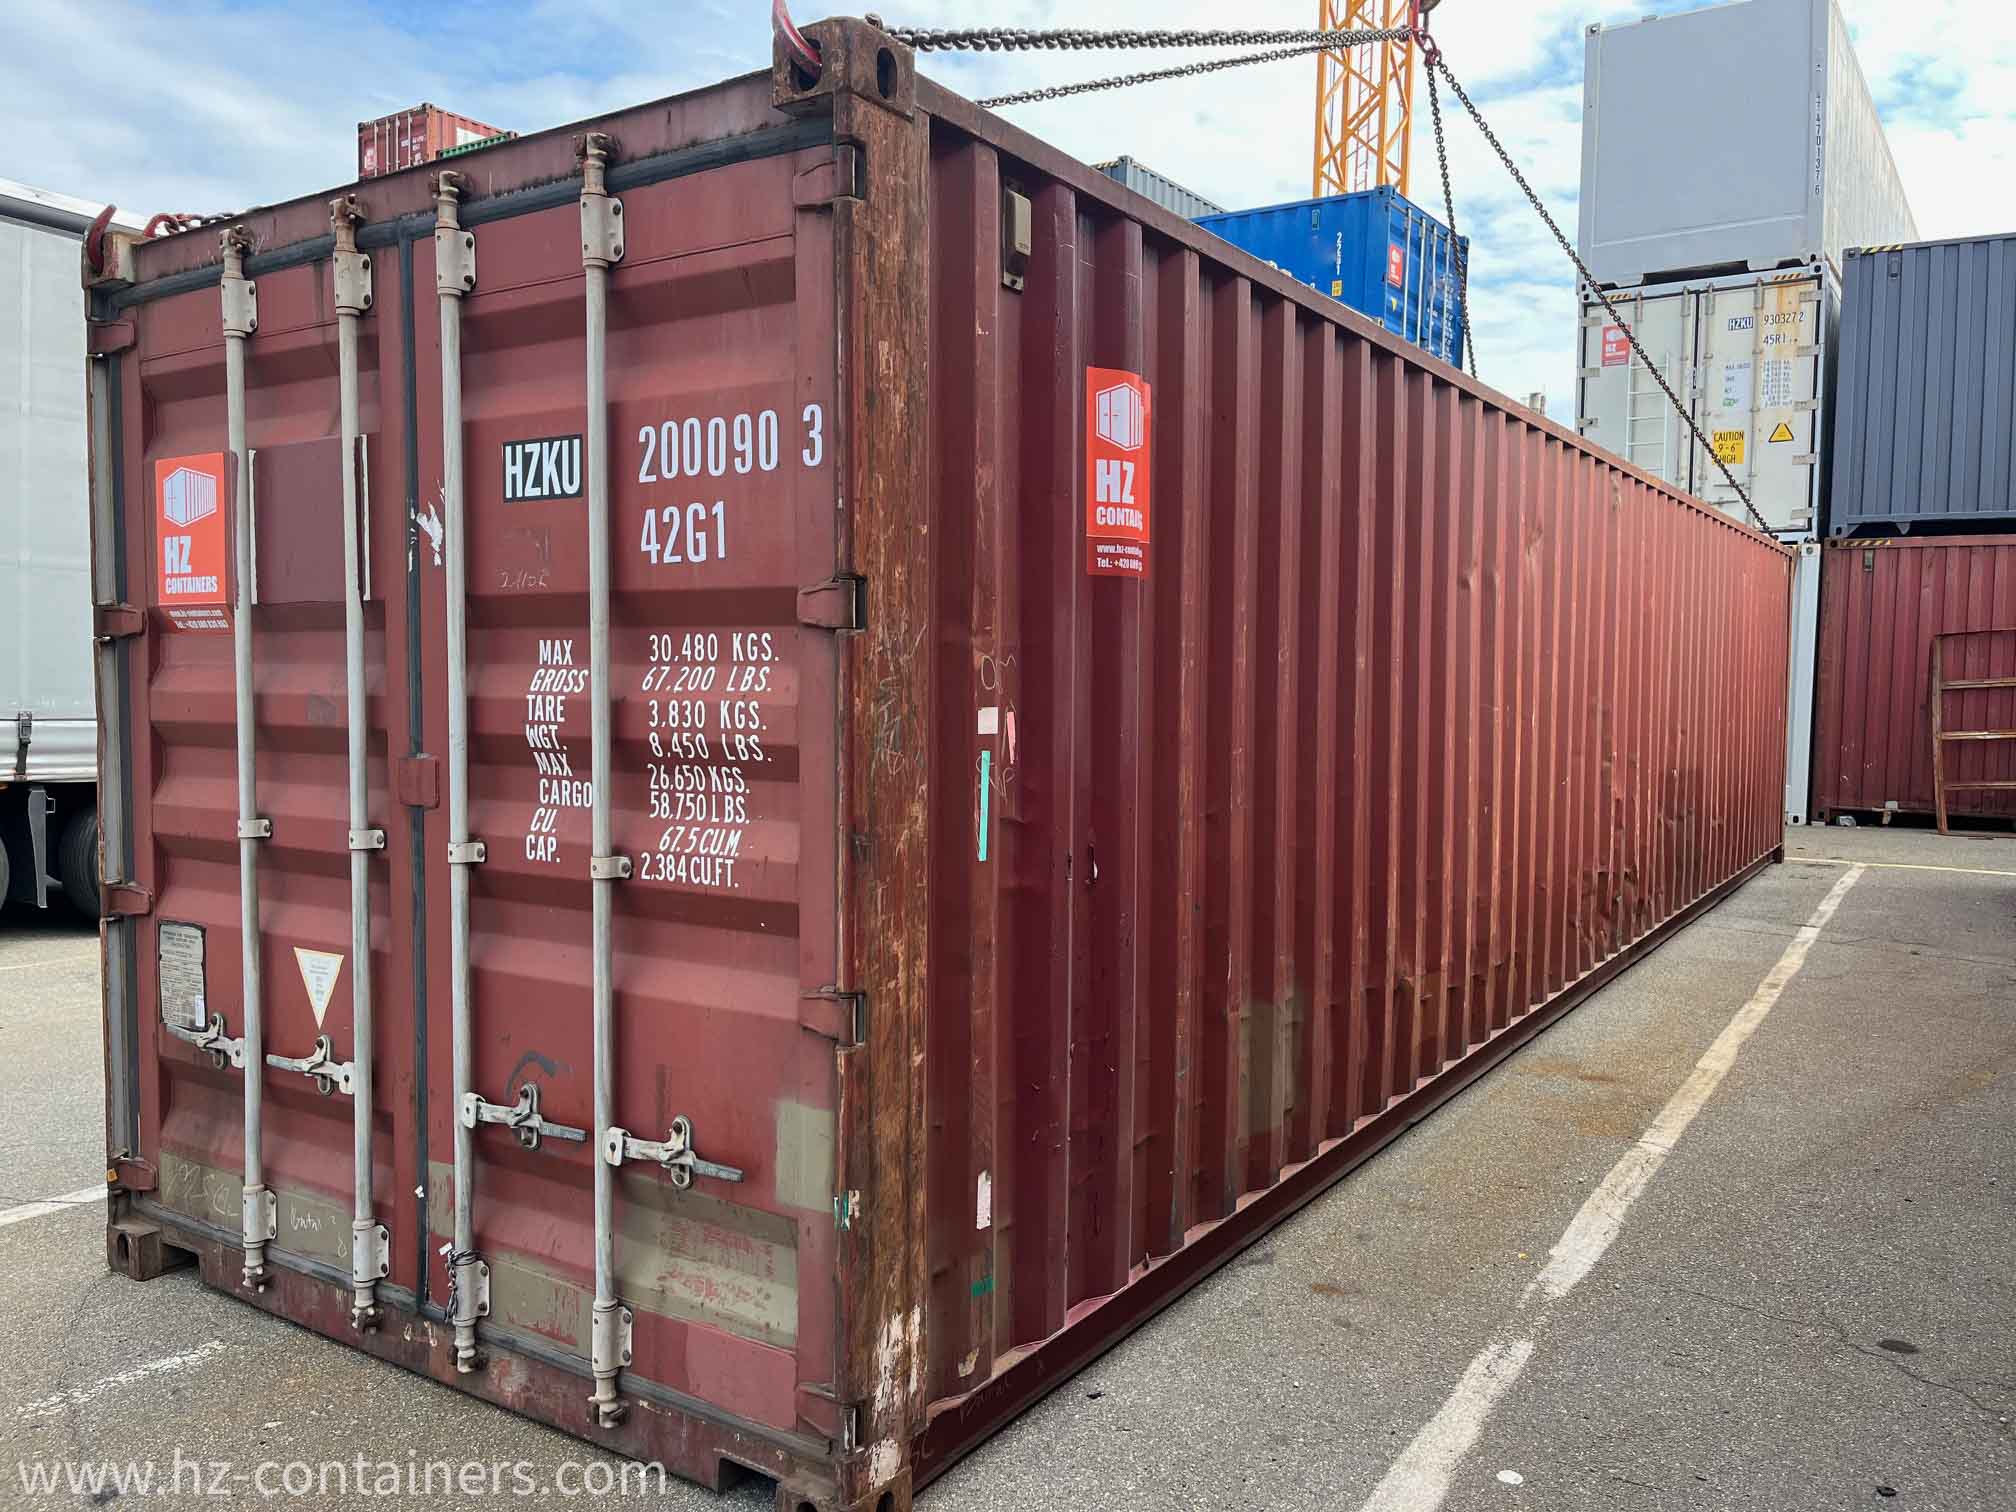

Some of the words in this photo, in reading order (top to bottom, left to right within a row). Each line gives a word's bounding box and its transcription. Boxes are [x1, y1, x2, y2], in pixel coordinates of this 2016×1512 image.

[1728, 317, 1753, 331] HZKU
[1763, 311, 1797, 326] 930327
[1713, 431, 1744, 442] CAUTION
[505, 438, 581, 498] HZKU
[638, 409, 779, 483] 200090
[802, 404, 823, 467] 3
[1096, 459, 1135, 504] HZ
[640, 501, 727, 564] 42G1
[164, 535, 192, 575] HZ
[165, 576, 218, 594] CONTAINERS
[539, 639, 573, 665] MAX
[733, 632, 779, 662] KGS.
[530, 668, 589, 693] GROSS
[726, 666, 772, 692] LBS.
[526, 694, 566, 722] TARE
[720, 700, 767, 730] KGS.
[525, 724, 567, 750] WGT.
[721, 733, 772, 762] LBS.
[533, 751, 573, 777] MAX
[539, 778, 592, 807] CARGO
[708, 766, 751, 794] KGS.
[530, 806, 558, 833] CU.
[711, 794, 751, 824] LBS.
[525, 834, 561, 863] CAP.
